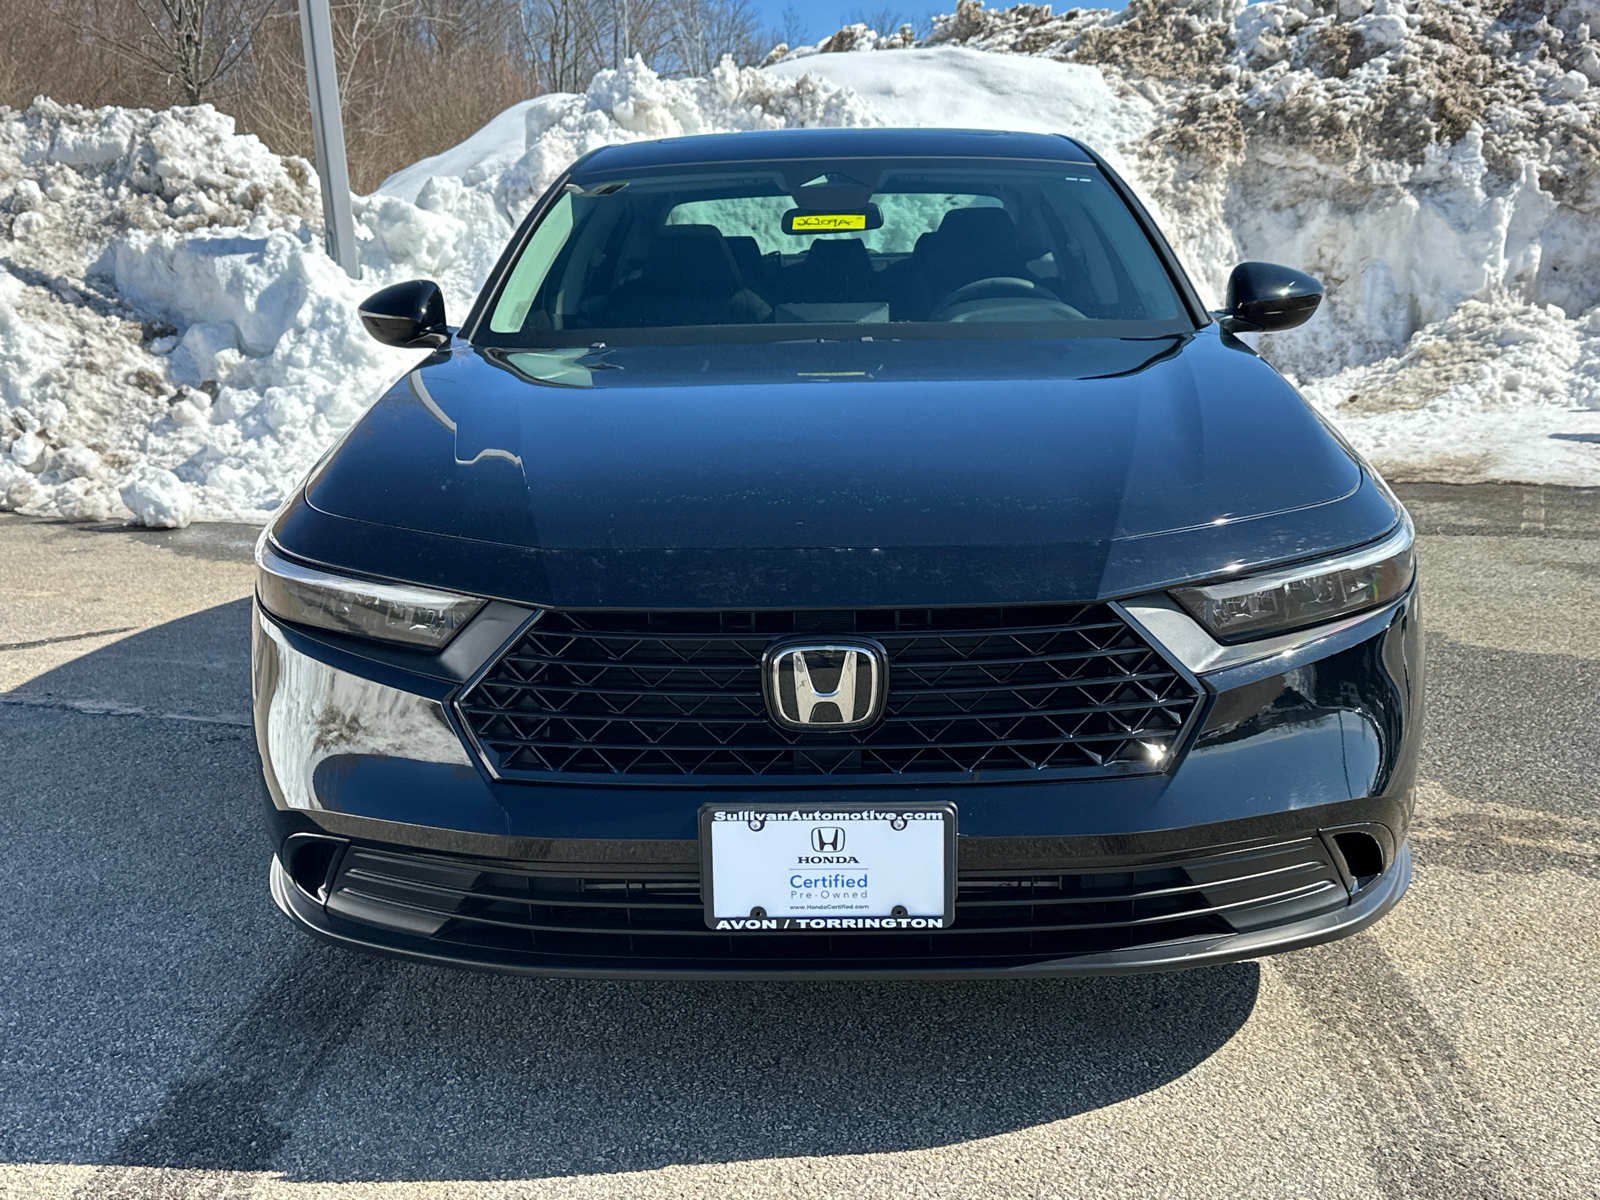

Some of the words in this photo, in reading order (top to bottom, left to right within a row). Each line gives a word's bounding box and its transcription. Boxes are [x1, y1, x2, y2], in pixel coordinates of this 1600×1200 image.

[714, 810, 943, 821] SullivanAutomotive.com
[797, 856, 860, 864] HONDA
[790, 874, 868, 888] Certified
[790, 890, 868, 899] Pre-Owned
[716, 920, 777, 929] AVON
[784, 919, 790, 929] /
[796, 918, 943, 929] TORRINGTON
